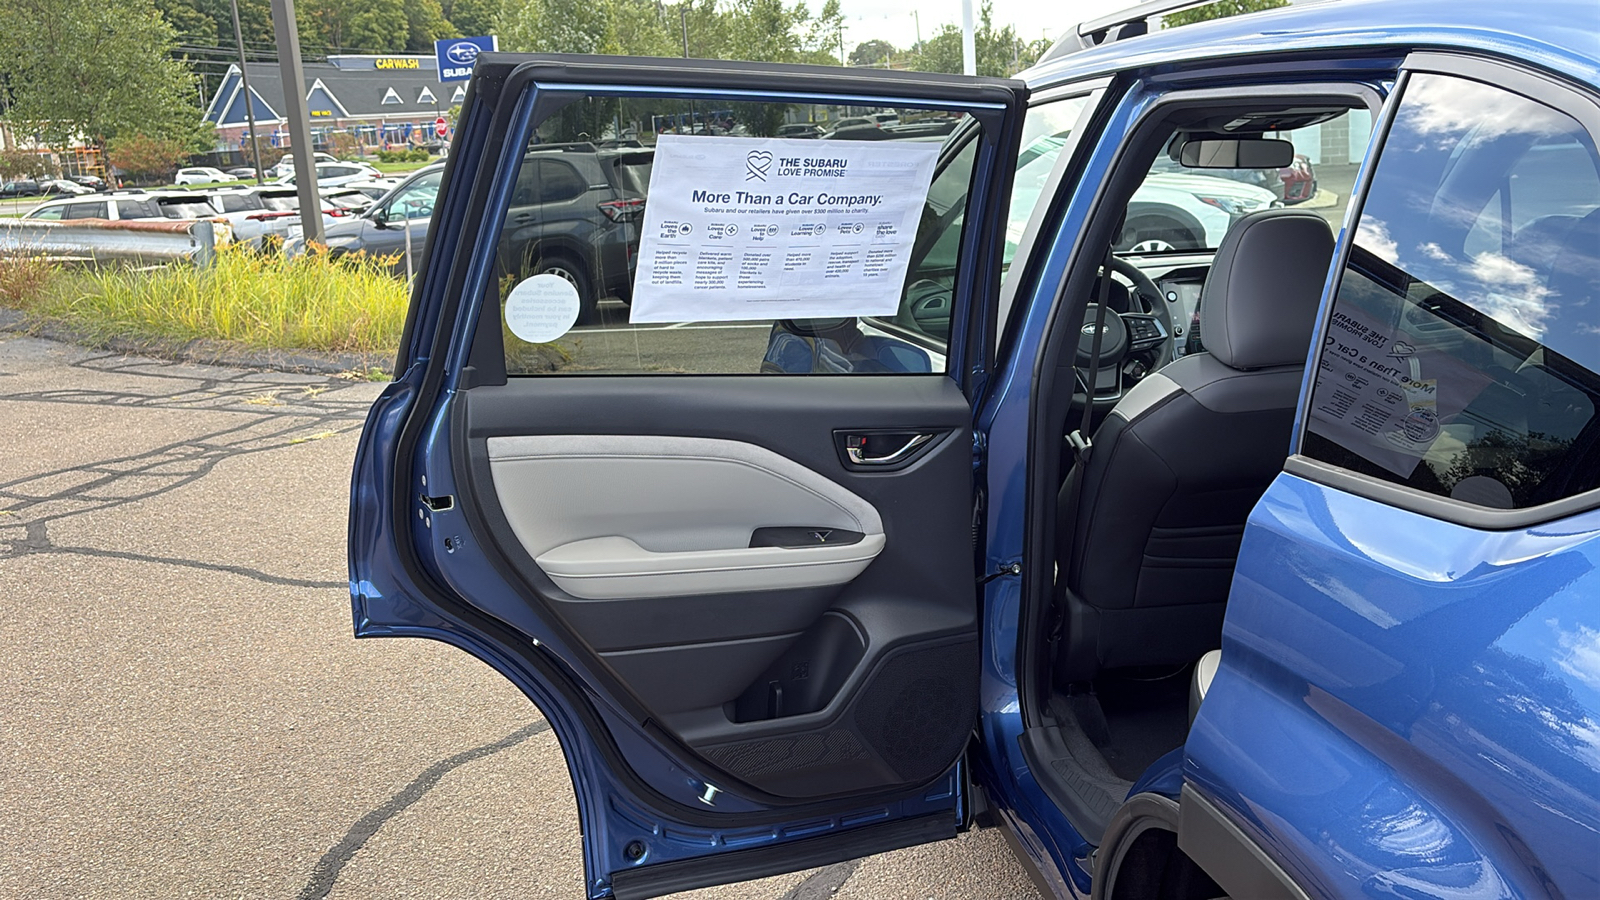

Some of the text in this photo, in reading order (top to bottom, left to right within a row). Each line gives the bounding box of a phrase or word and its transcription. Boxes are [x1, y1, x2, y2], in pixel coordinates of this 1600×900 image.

[443, 67, 472, 77] SUBA
[779, 158, 847, 168] THE SUBARU
[778, 168, 845, 177] LOVE PROMISE
[692, 190, 881, 207] More Than a Car Company.
